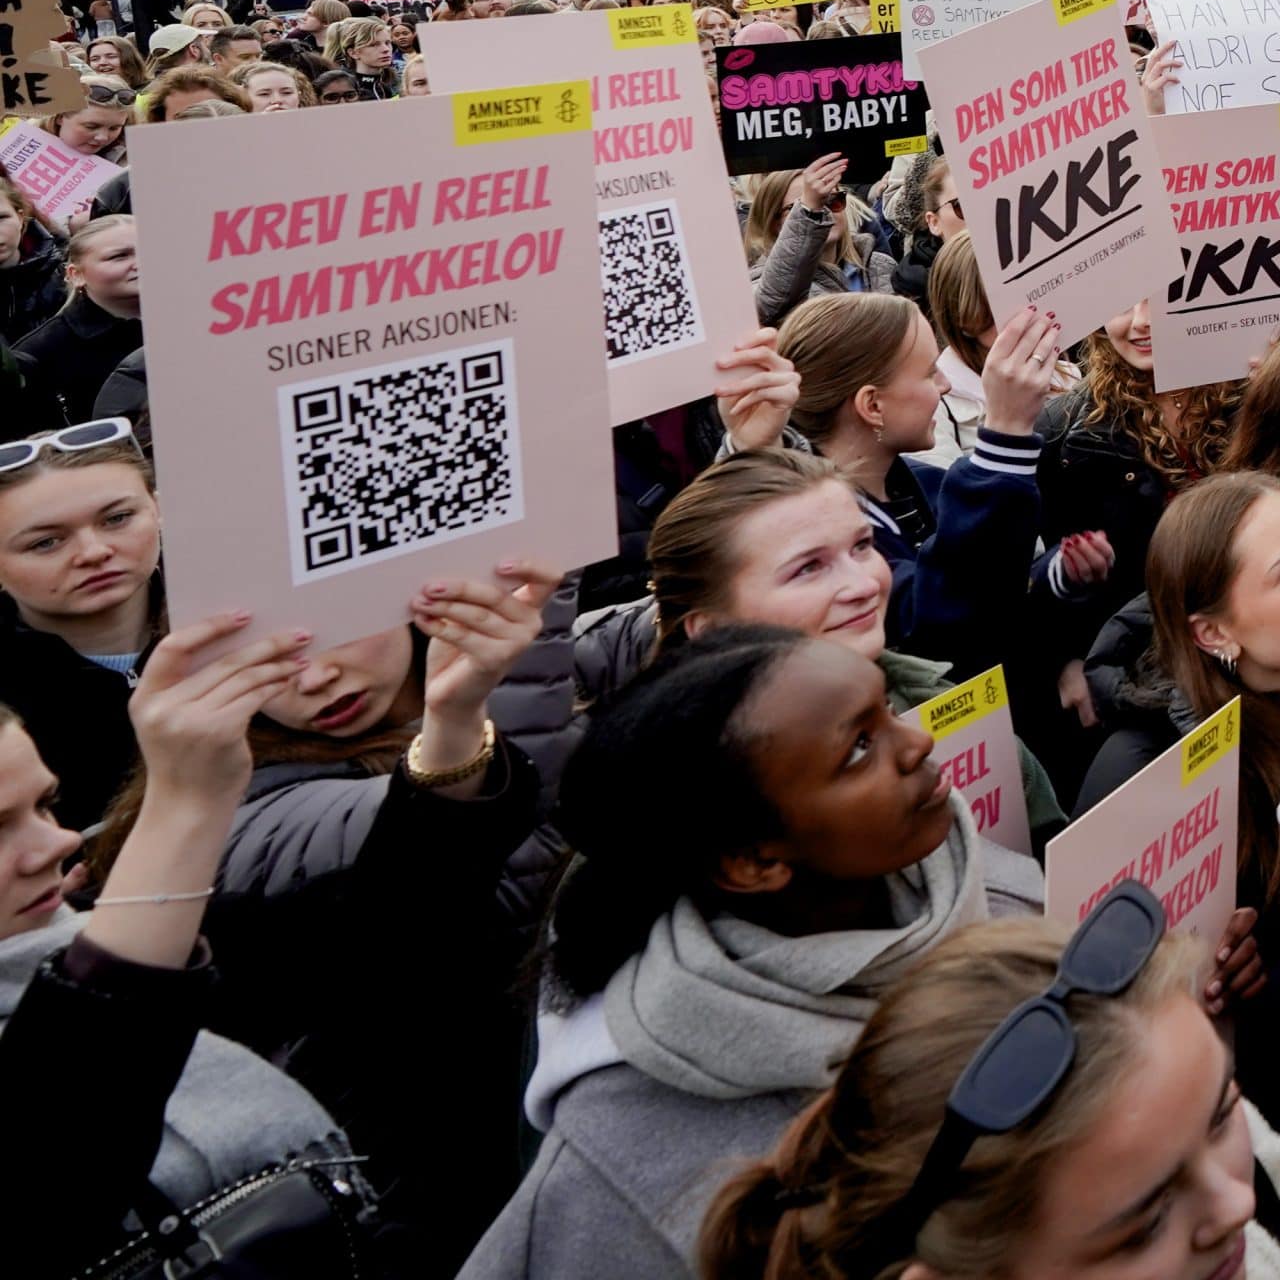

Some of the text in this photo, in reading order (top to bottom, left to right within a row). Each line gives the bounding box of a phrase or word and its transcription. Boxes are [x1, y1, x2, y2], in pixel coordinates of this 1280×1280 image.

[618, 16, 662, 30] AMNESTY
[878, 3, 895, 16] er
[1162, 2, 1228, 30] HAN
[1170, 34, 1252, 73] ALDRI
[468, 97, 541, 120] AMNESTY
[609, 68, 680, 110] REELL
[955, 38, 1119, 144] DEN SOM TIER
[468, 115, 542, 133] INTERNATIONAL
[736, 95, 908, 141] MEG, BABY!
[968, 79, 1130, 190] SAMTYKKER
[1214, 154, 1275, 190] SOM
[208, 164, 552, 262] KREV EN REELL
[995, 129, 1142, 270] IKKE
[208, 228, 563, 336] SAMTYKKELOV
[1026, 226, 1147, 303] VOLDTEKT SEX UTEN SAMTYKKE
[267, 301, 518, 372] SIGNER AKSJONEN:
[1186, 312, 1280, 337] VOLDTEKT SEX UTEN
[930, 690, 974, 722] AMNESTY
[1188, 724, 1220, 759] AMNESTY
[1140, 786, 1220, 889] EN REELL
